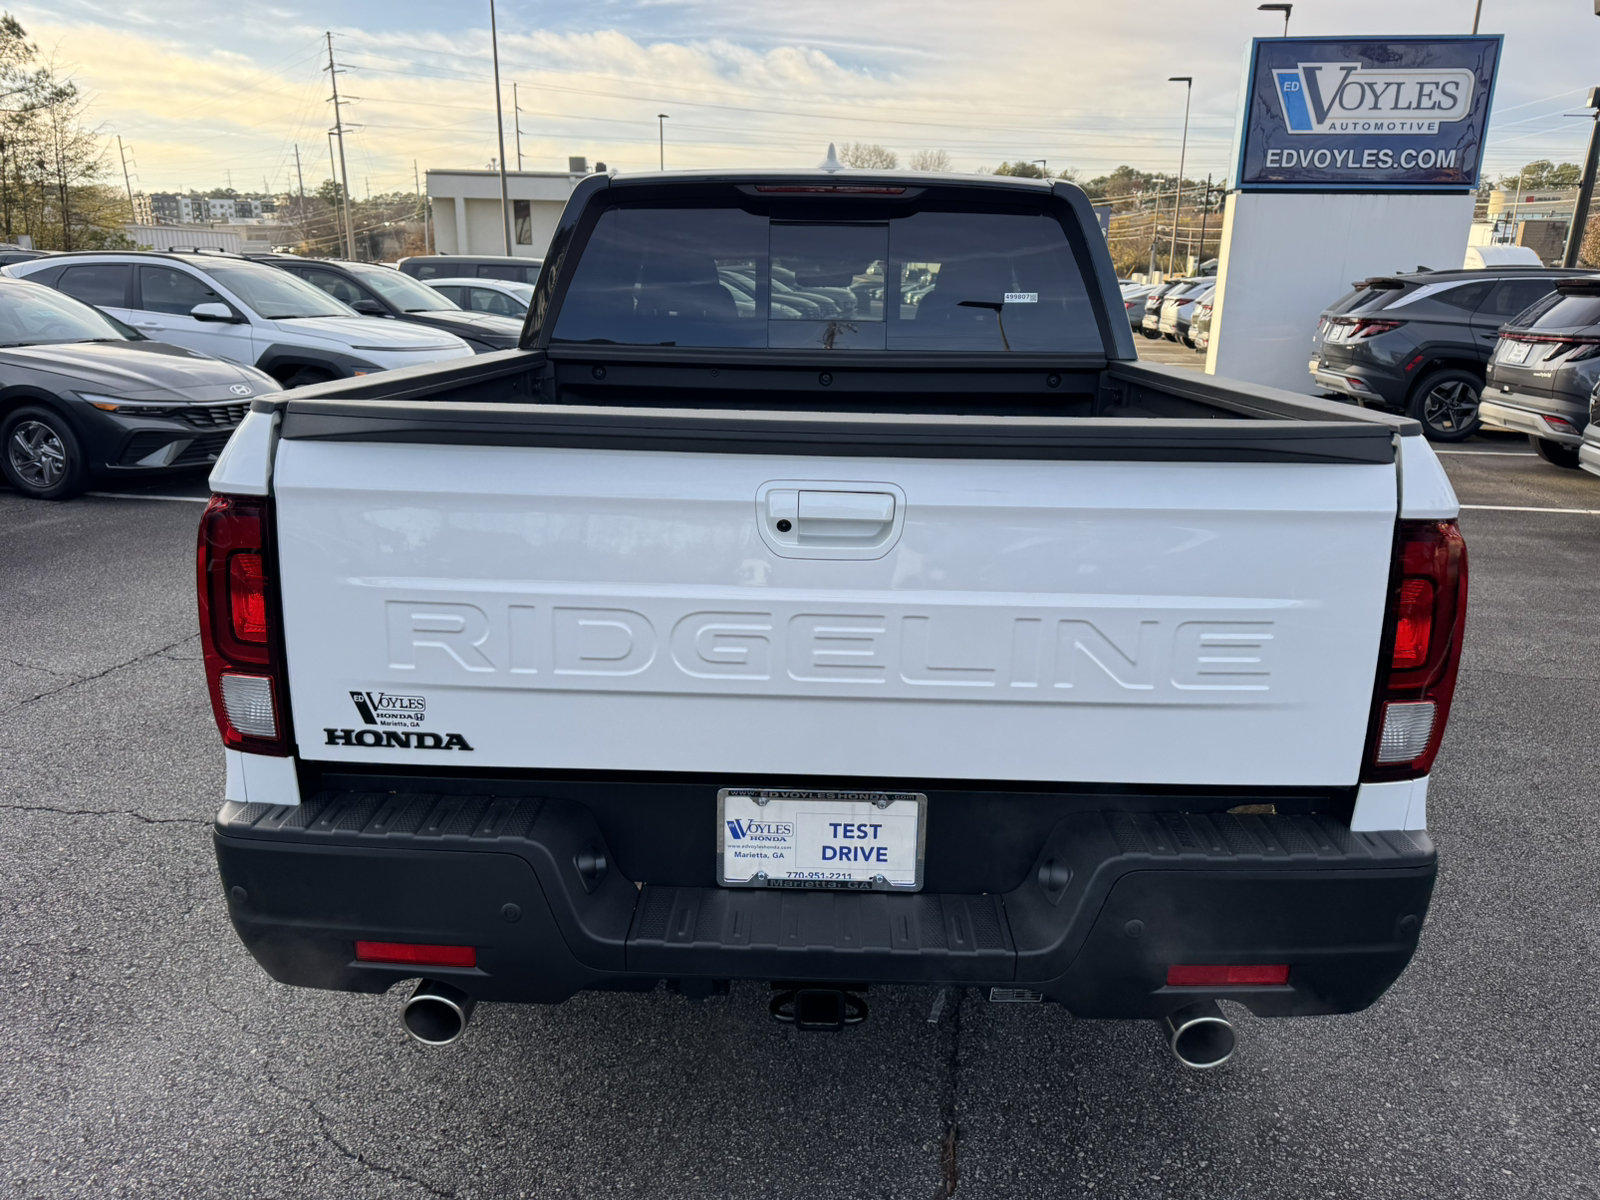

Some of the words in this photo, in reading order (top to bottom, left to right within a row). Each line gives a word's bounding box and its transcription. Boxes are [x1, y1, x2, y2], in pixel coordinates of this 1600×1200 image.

[1284, 81, 1300, 92] ED
[1302, 66, 1460, 125] VOYLES
[1328, 122, 1437, 131] AUTOMOTIVE
[1265, 149, 1458, 169] EDVOYLES.COM
[384, 599, 1275, 691] RIDGELINE
[366, 692, 424, 711] VOYLES
[380, 720, 409, 728] Marietta,
[323, 728, 474, 751] HONDA
[734, 819, 791, 838] VOYLES
[829, 822, 883, 840] TEST
[734, 851, 770, 859] Marietta,
[821, 845, 888, 863] DRIVE
[786, 871, 852, 879] 770-951-2211
[847, 881, 870, 889] GA
